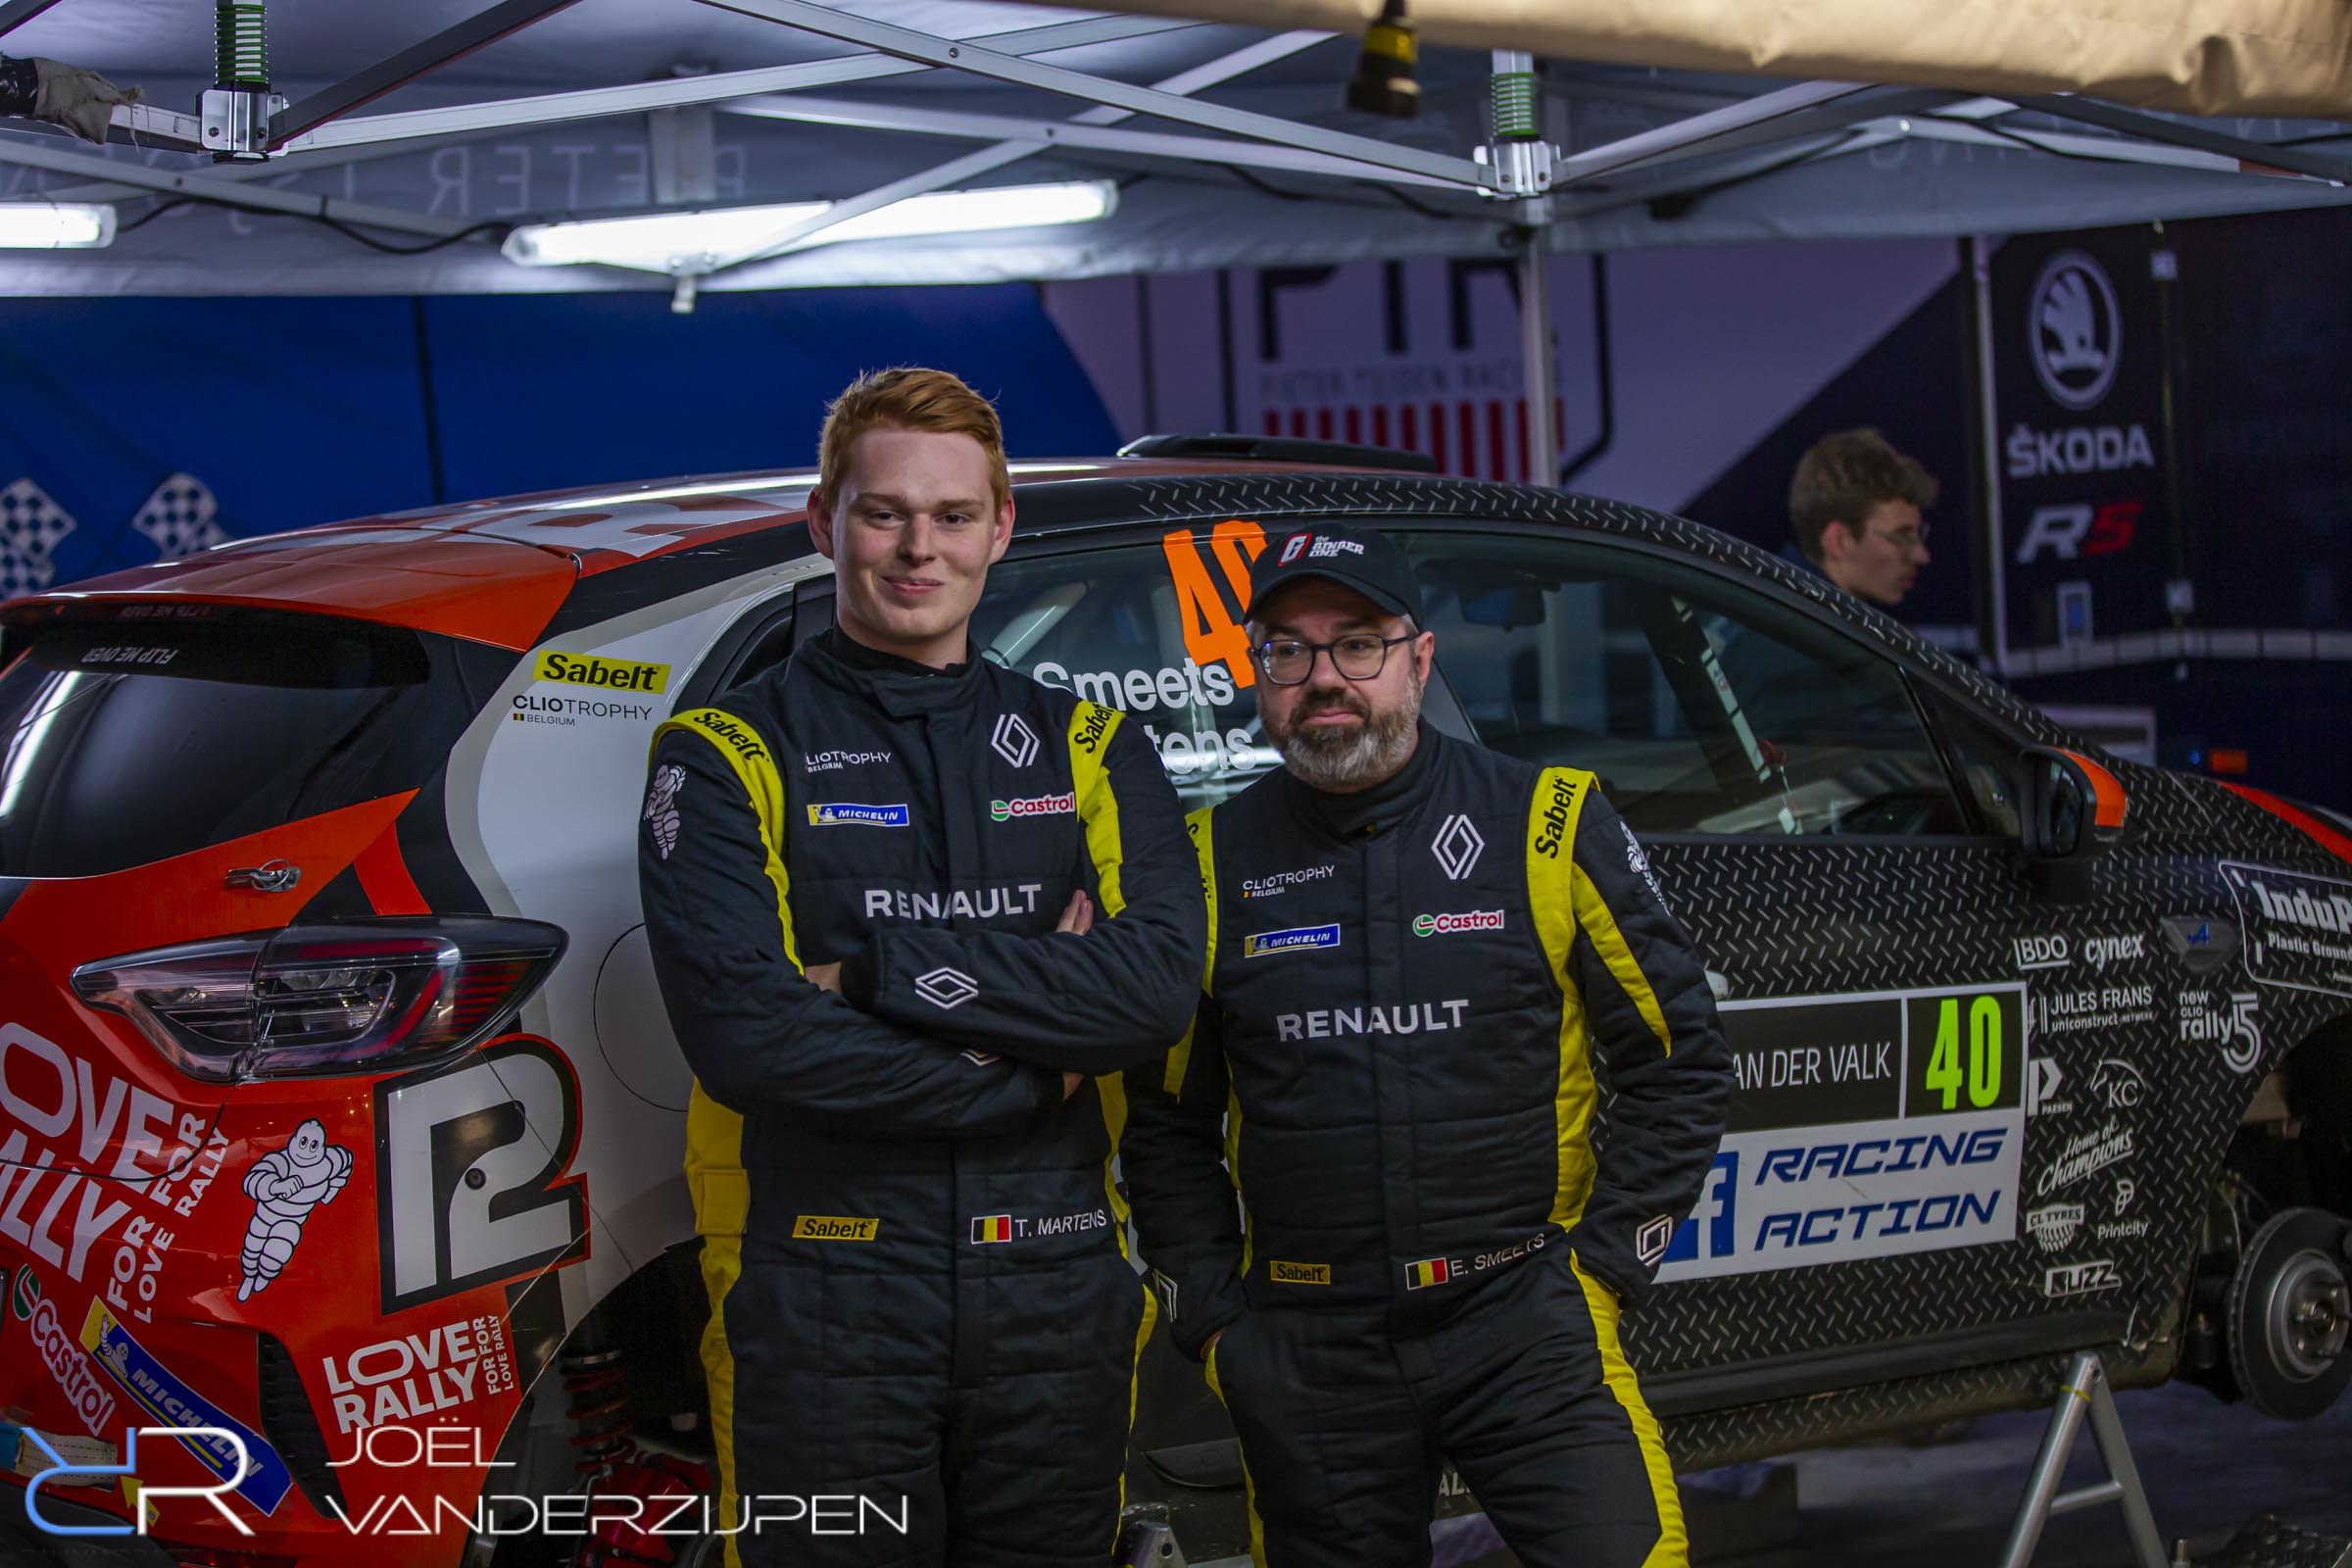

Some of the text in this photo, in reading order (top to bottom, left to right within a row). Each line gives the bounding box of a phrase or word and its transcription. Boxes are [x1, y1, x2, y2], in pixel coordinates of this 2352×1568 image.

[2007, 422, 2155, 478] ŠKODA
[2017, 502, 2144, 564] R5
[81, 647, 178, 664] FLIP ME OVER
[543, 654, 658, 691] Sabelt
[513, 695, 654, 721] CLIOTROPHY
[526, 713, 576, 726] BELGIUM
[693, 710, 765, 761] Sabelt
[1145, 720, 1258, 774] tens
[806, 751, 892, 766] LIOTROPHY
[807, 762, 843, 773] BELGIUM
[838, 809, 899, 821] MICHELIN
[1010, 795, 1074, 815] Castrol
[1535, 775, 1578, 859] Sabelt
[1243, 864, 1336, 891] CLIOTROPHY
[1251, 886, 1286, 899] BELGIUM
[864, 883, 1043, 920] RENAULT
[1270, 932, 1331, 948] MICHELIN
[1436, 911, 1504, 932] Castrol
[2020, 934, 2069, 963] BDO
[2084, 932, 2146, 973] cynex
[2267, 931, 2310, 955] Plastic
[2050, 990, 2097, 1016] JULES
[2102, 984, 2153, 1009] FRANS
[2179, 990, 2211, 1006] new
[1276, 999, 1470, 1043] RENAULT
[2180, 993, 2262, 1075] rally 5
[1733, 1041, 1892, 1091] AN DER VALK
[1925, 995, 2002, 1110] 40
[0, 1022, 174, 1195] OVE
[2107, 1079, 2139, 1108] KC
[149, 1112, 206, 1207] FOR
[1754, 1127, 2009, 1187] RACING
[2037, 1127, 2134, 1197] Champions
[2064, 1130, 2100, 1161] Home
[173, 1126, 229, 1217] RALLY
[0, 1129, 132, 1283] ALLY
[1014, 1208, 1107, 1238] T. MARTENS
[1753, 1189, 2002, 1252] ACTION
[2045, 1207, 2082, 1223] TYRES
[802, 1218, 869, 1239] Sabelt
[2097, 1220, 2149, 1241] Printcity
[107, 1214, 155, 1311] FOR
[133, 1227, 175, 1324] LOVE
[1276, 1262, 1325, 1282] Sabelt
[1450, 1259, 1469, 1278] E.
[472, 1316, 493, 1357] FOR
[487, 1314, 506, 1350] RALLY
[32, 1298, 116, 1436] Castrol
[322, 1320, 477, 1396] LOVE
[482, 1356, 502, 1396] FOR
[498, 1352, 514, 1391] LOVE
[332, 1360, 478, 1435] RALLY
[131, 1368, 265, 1477] MICHELIN
